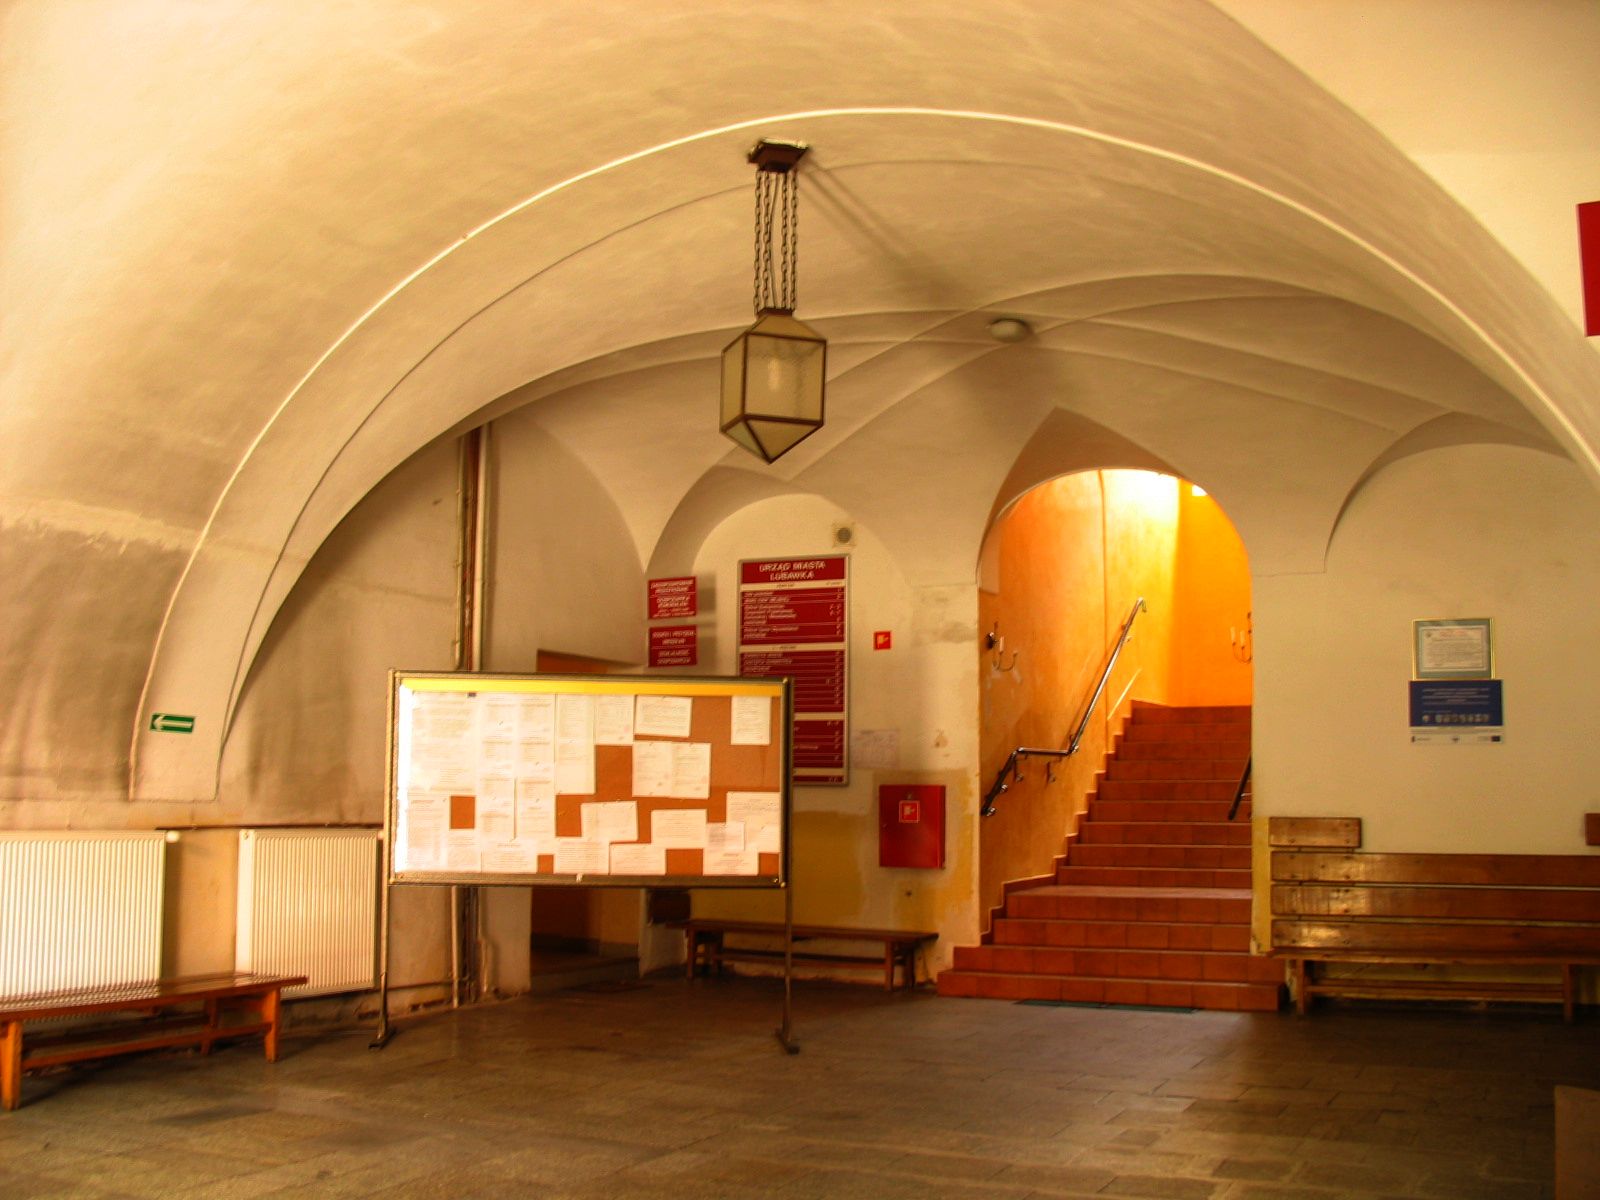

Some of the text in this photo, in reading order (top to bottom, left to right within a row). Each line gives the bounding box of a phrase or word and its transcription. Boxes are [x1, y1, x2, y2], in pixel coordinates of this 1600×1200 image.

[759, 560, 826, 573] URZĄD MIASTA
[770, 571, 815, 581] LUBAWKA
